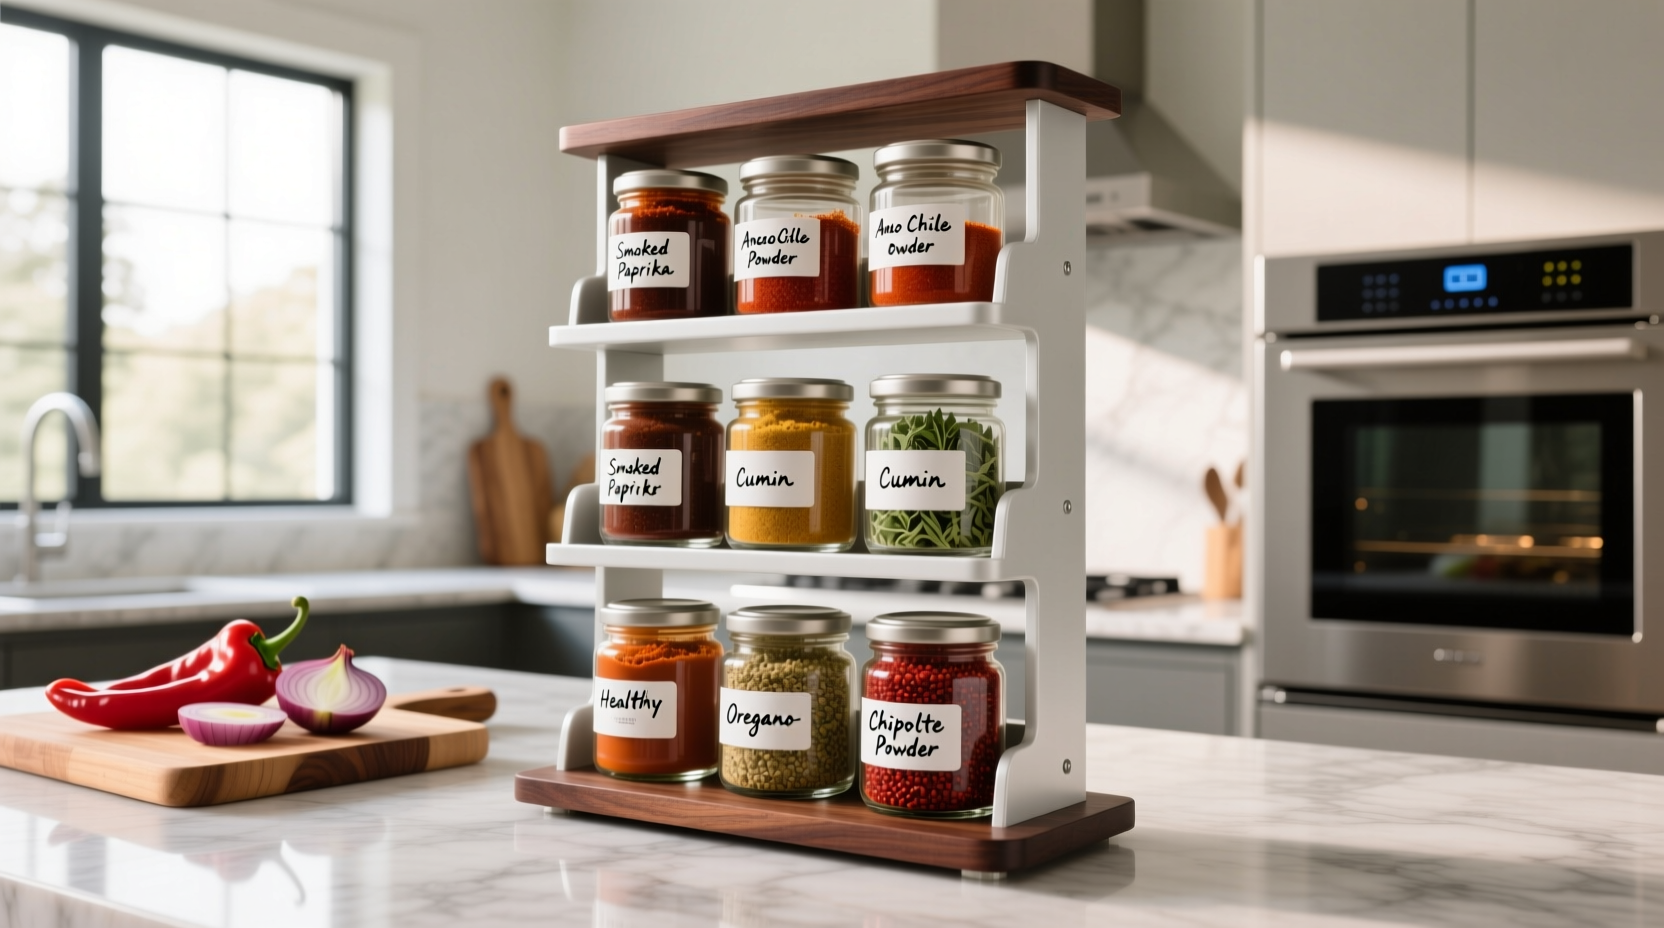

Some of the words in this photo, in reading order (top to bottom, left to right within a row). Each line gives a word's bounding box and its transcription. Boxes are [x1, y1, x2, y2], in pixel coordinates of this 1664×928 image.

[906, 212, 952, 233] Chile
[616, 237, 670, 259] Smoked
[618, 258, 675, 284] Paprika
[736, 466, 795, 488] Cumin
[879, 466, 947, 489] Cumin
[726, 702, 802, 738] Oregano
[869, 709, 945, 737] Chipolte
[875, 734, 940, 758] Powder
